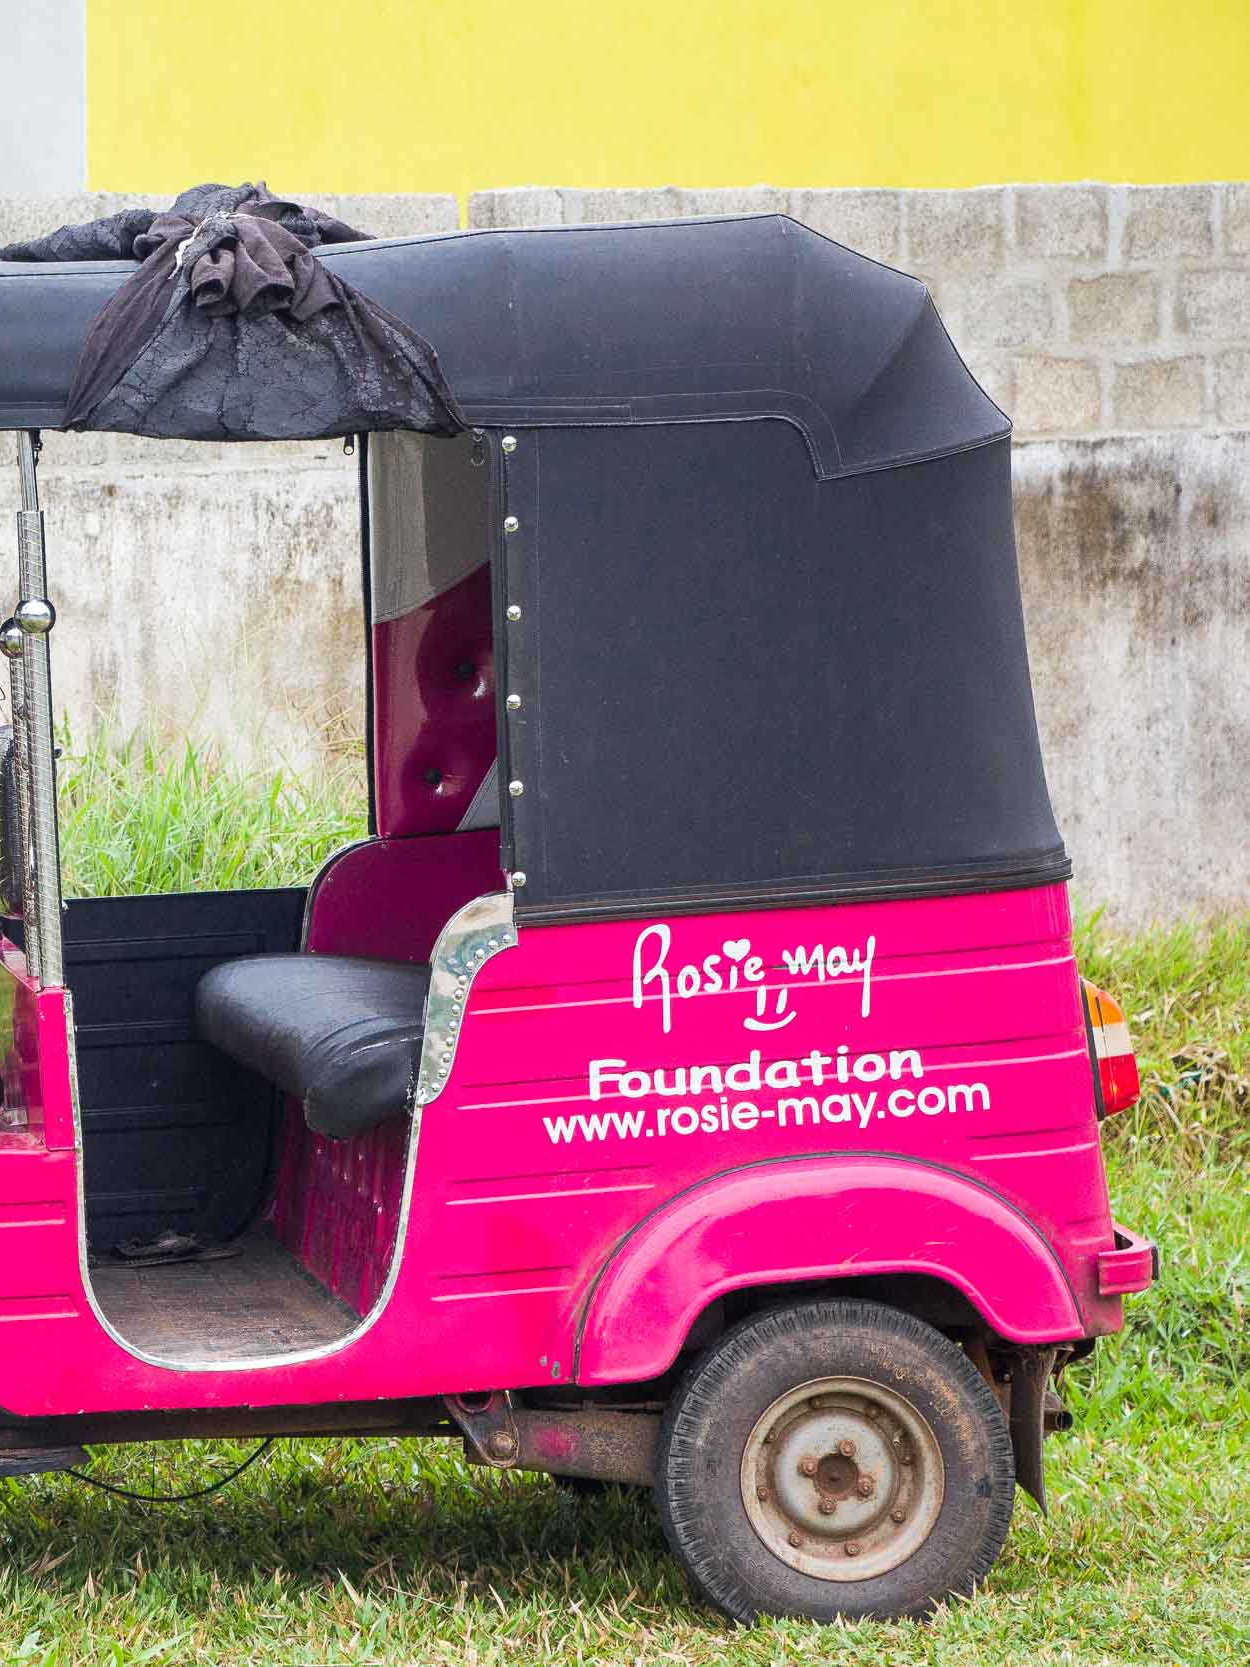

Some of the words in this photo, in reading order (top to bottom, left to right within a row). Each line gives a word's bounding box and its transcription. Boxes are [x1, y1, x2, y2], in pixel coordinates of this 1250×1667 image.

[632, 923, 765, 1034] Rosie
[588, 1045, 925, 1101] Foundation
[543, 1082, 992, 1144] www.rosie-may.com
